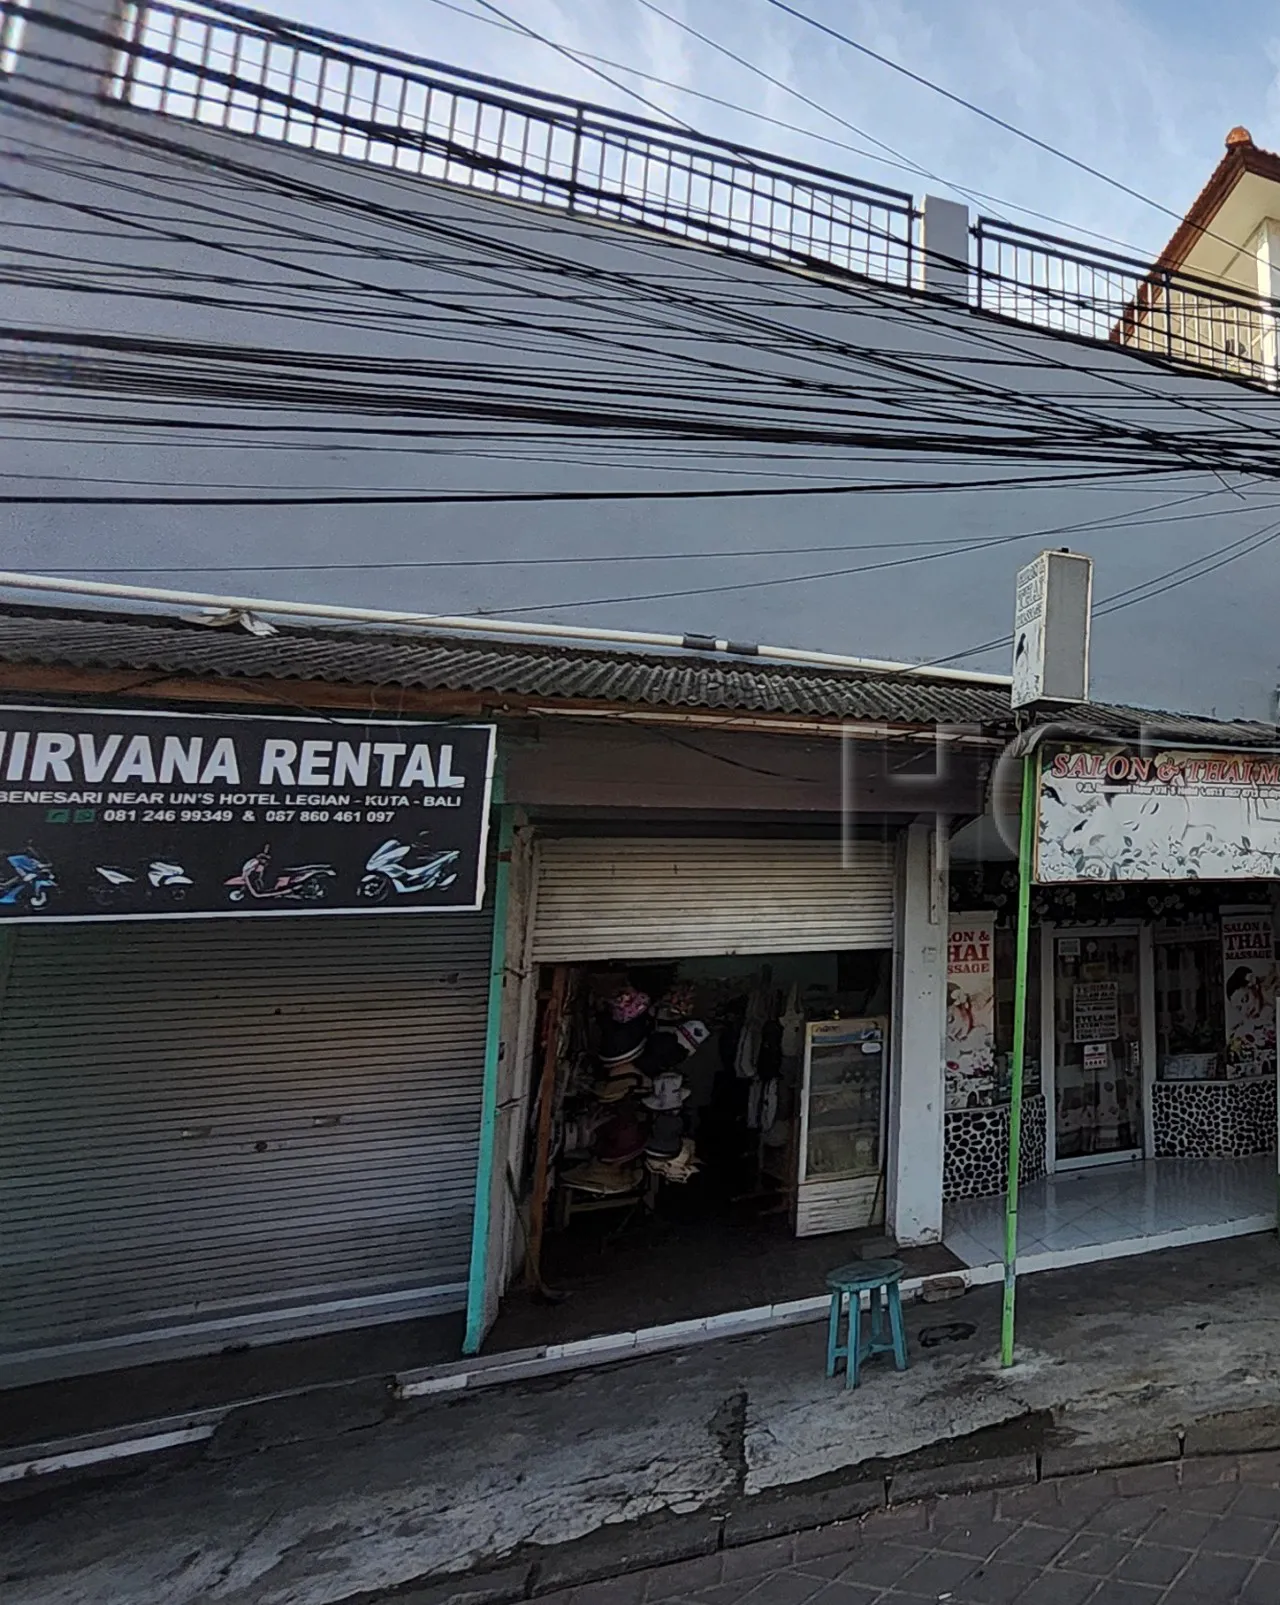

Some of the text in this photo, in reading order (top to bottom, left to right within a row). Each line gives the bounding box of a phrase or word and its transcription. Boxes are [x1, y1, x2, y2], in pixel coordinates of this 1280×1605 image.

[0, 731, 466, 789] IRVANA RENTAL
[1051, 754, 1152, 782] SALON
[1157, 759, 1181, 783] &
[1183, 757, 1252, 784] THAI
[107, 792, 165, 805] NEAR
[169, 793, 215, 805] UN'S
[219, 793, 281, 806] HOTEL
[285, 794, 350, 806] LEGIAN
[365, 795, 410, 807] KUTA
[423, 796, 462, 807] BALI
[103, 810, 396, 823] 081 246 99349 & 087 860 461 097
[978, 930, 990, 942] &
[1224, 933, 1272, 950] THAI
